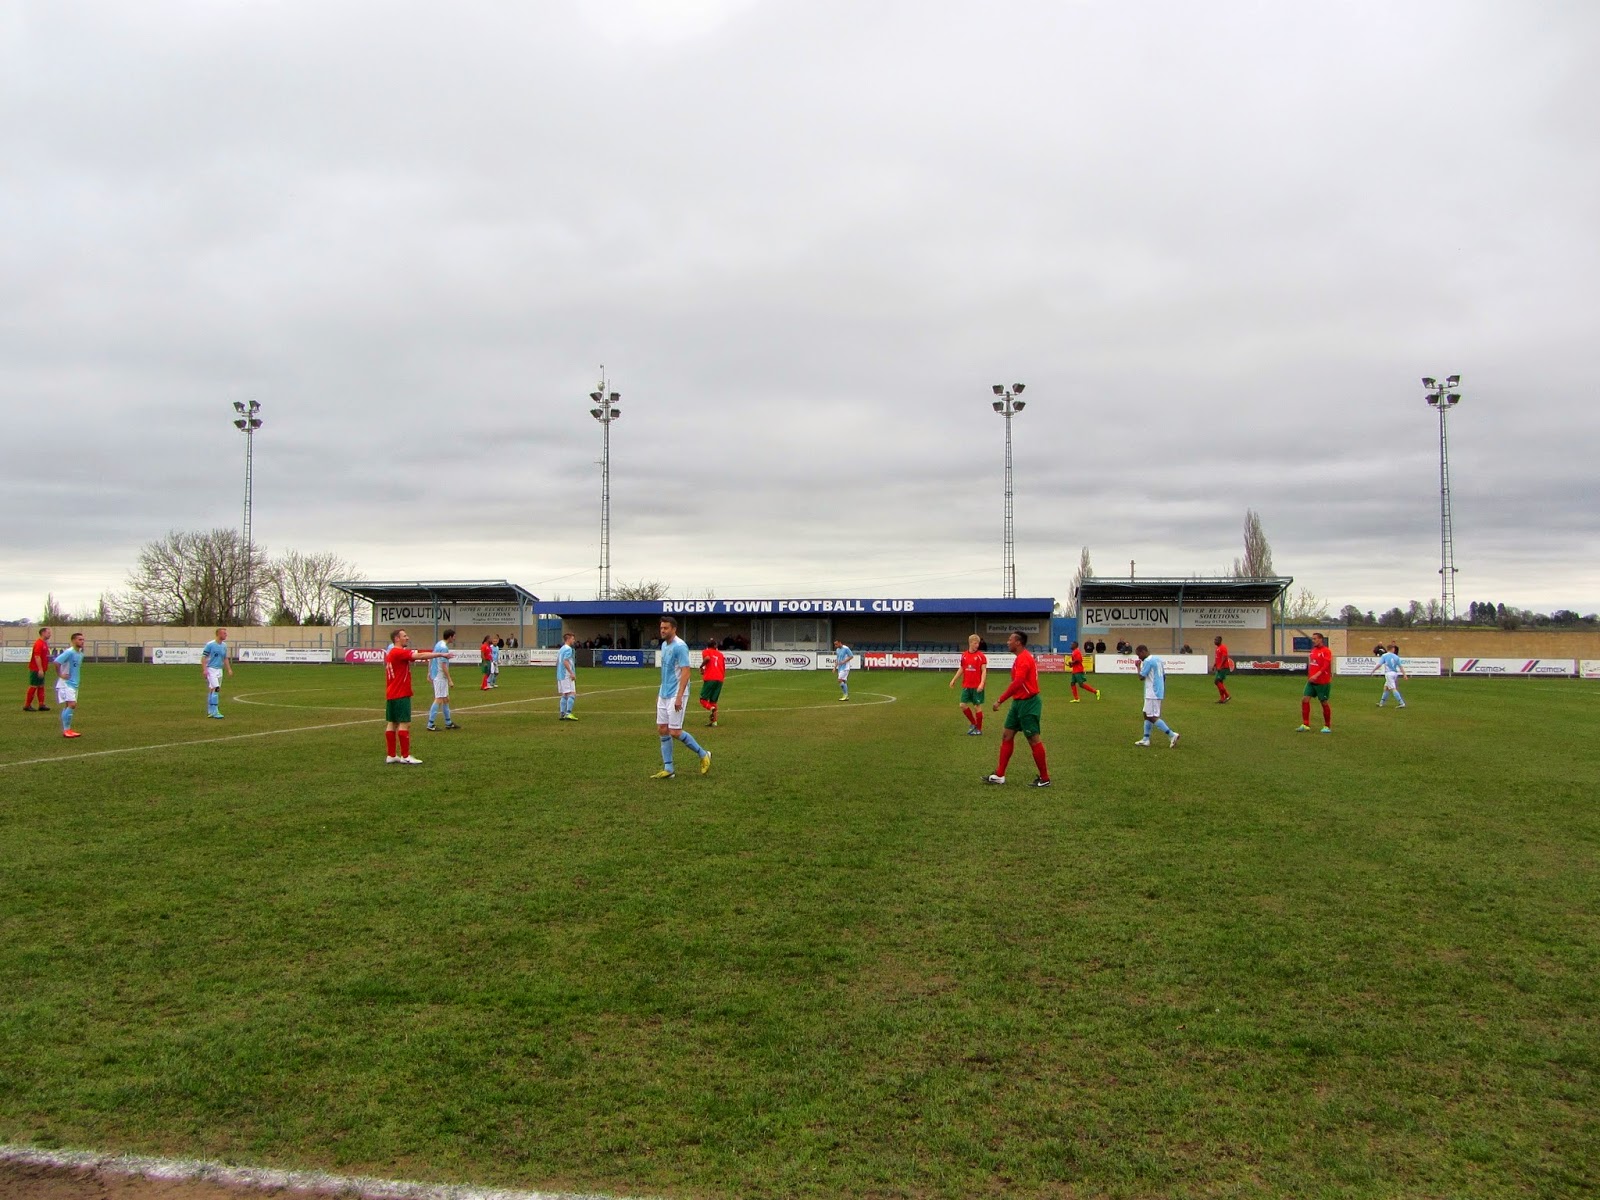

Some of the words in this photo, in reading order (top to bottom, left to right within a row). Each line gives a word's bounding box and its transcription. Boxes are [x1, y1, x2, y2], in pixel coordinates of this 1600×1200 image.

[662, 600, 717, 612] RUGBY
[723, 600, 772, 612] TOWN
[778, 600, 864, 612] FOOTBALL
[872, 600, 914, 612] CLUB
[381, 607, 450, 622] REVOLUTION
[1086, 608, 1168, 624] REVOLUTION
[353, 651, 384, 660] SYMON
[712, 655, 718, 667] 7
[865, 654, 918, 667] melbros
